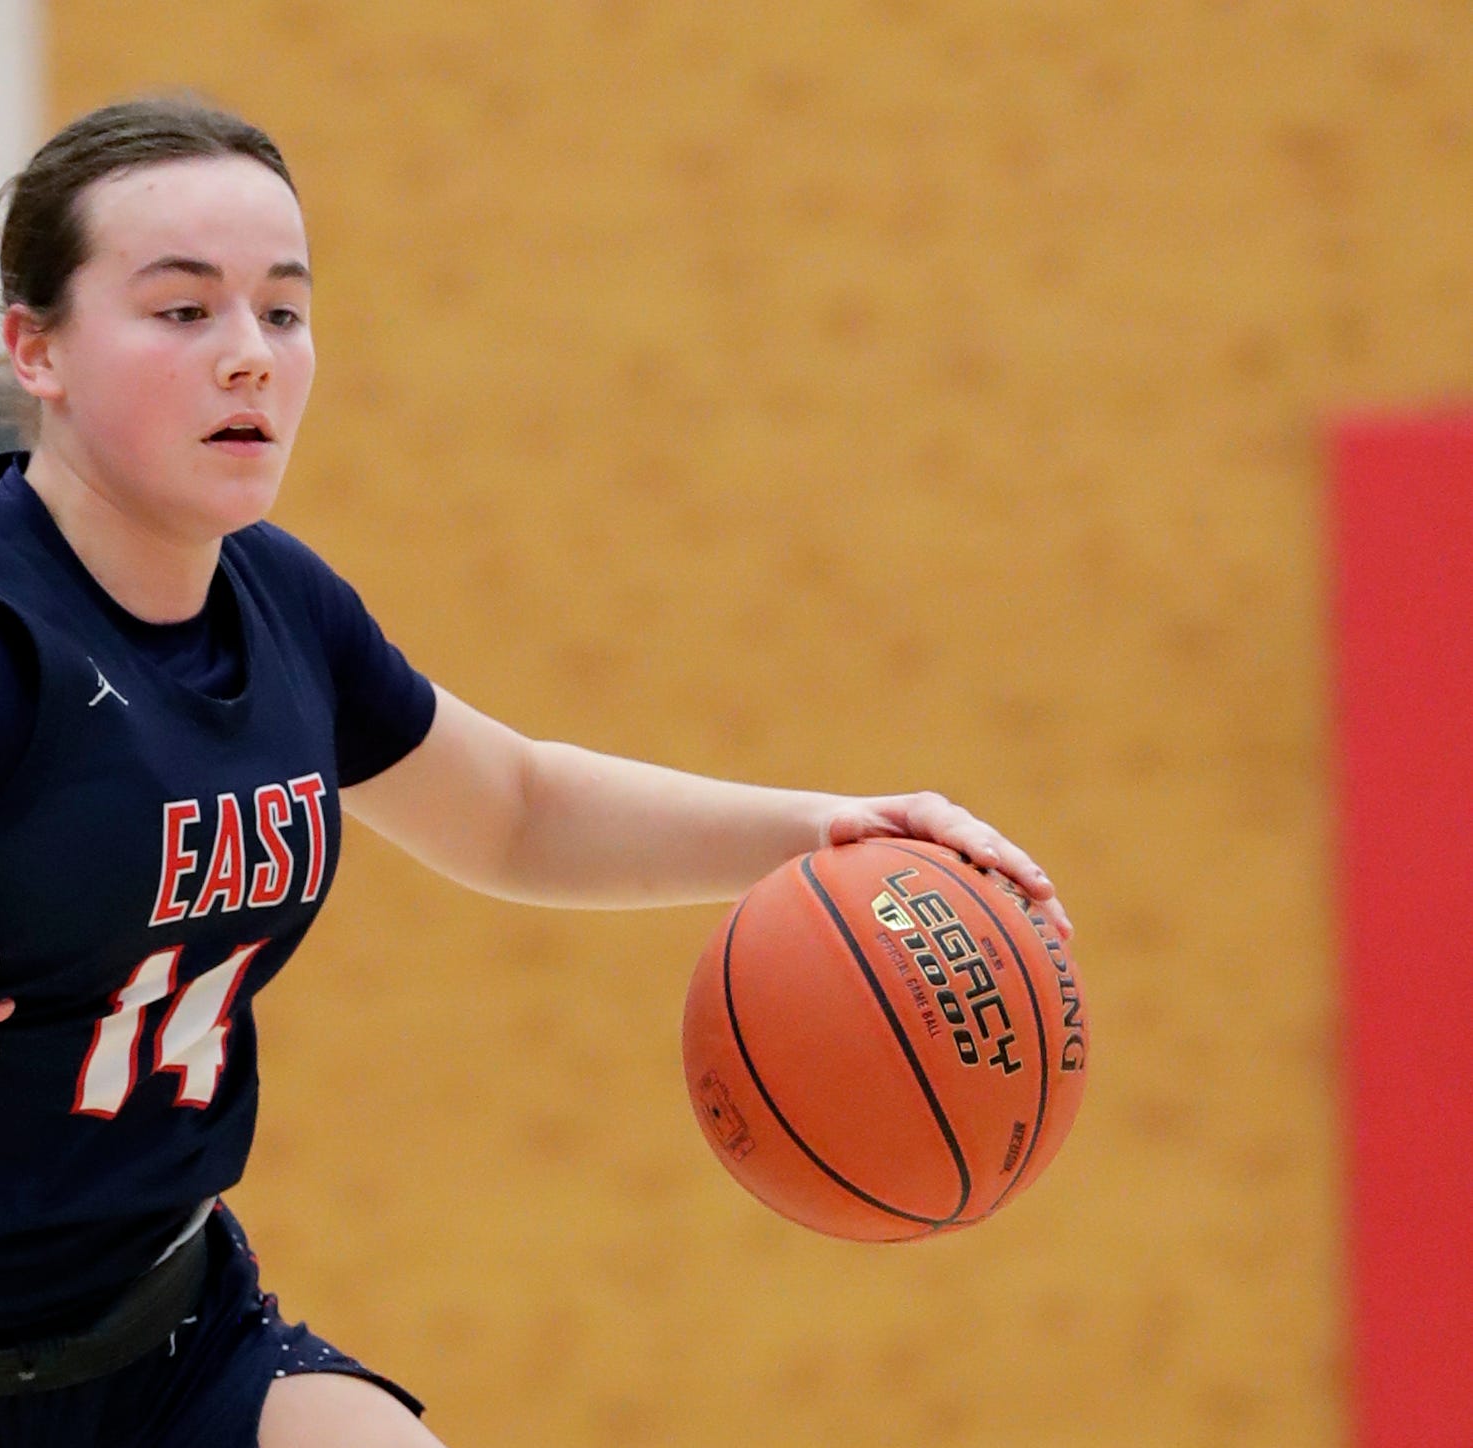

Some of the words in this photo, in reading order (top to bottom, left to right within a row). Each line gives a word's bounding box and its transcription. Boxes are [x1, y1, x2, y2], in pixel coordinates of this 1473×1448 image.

[148, 771, 327, 928] EAST
[70, 937, 272, 1121] 14
[877, 931, 910, 977] OFFICIAL
[906, 977, 930, 1011] GAME
[921, 1010, 943, 1040] BALL
[882, 867, 1023, 1077] LEGACY
[901, 931, 981, 1068] 1000
